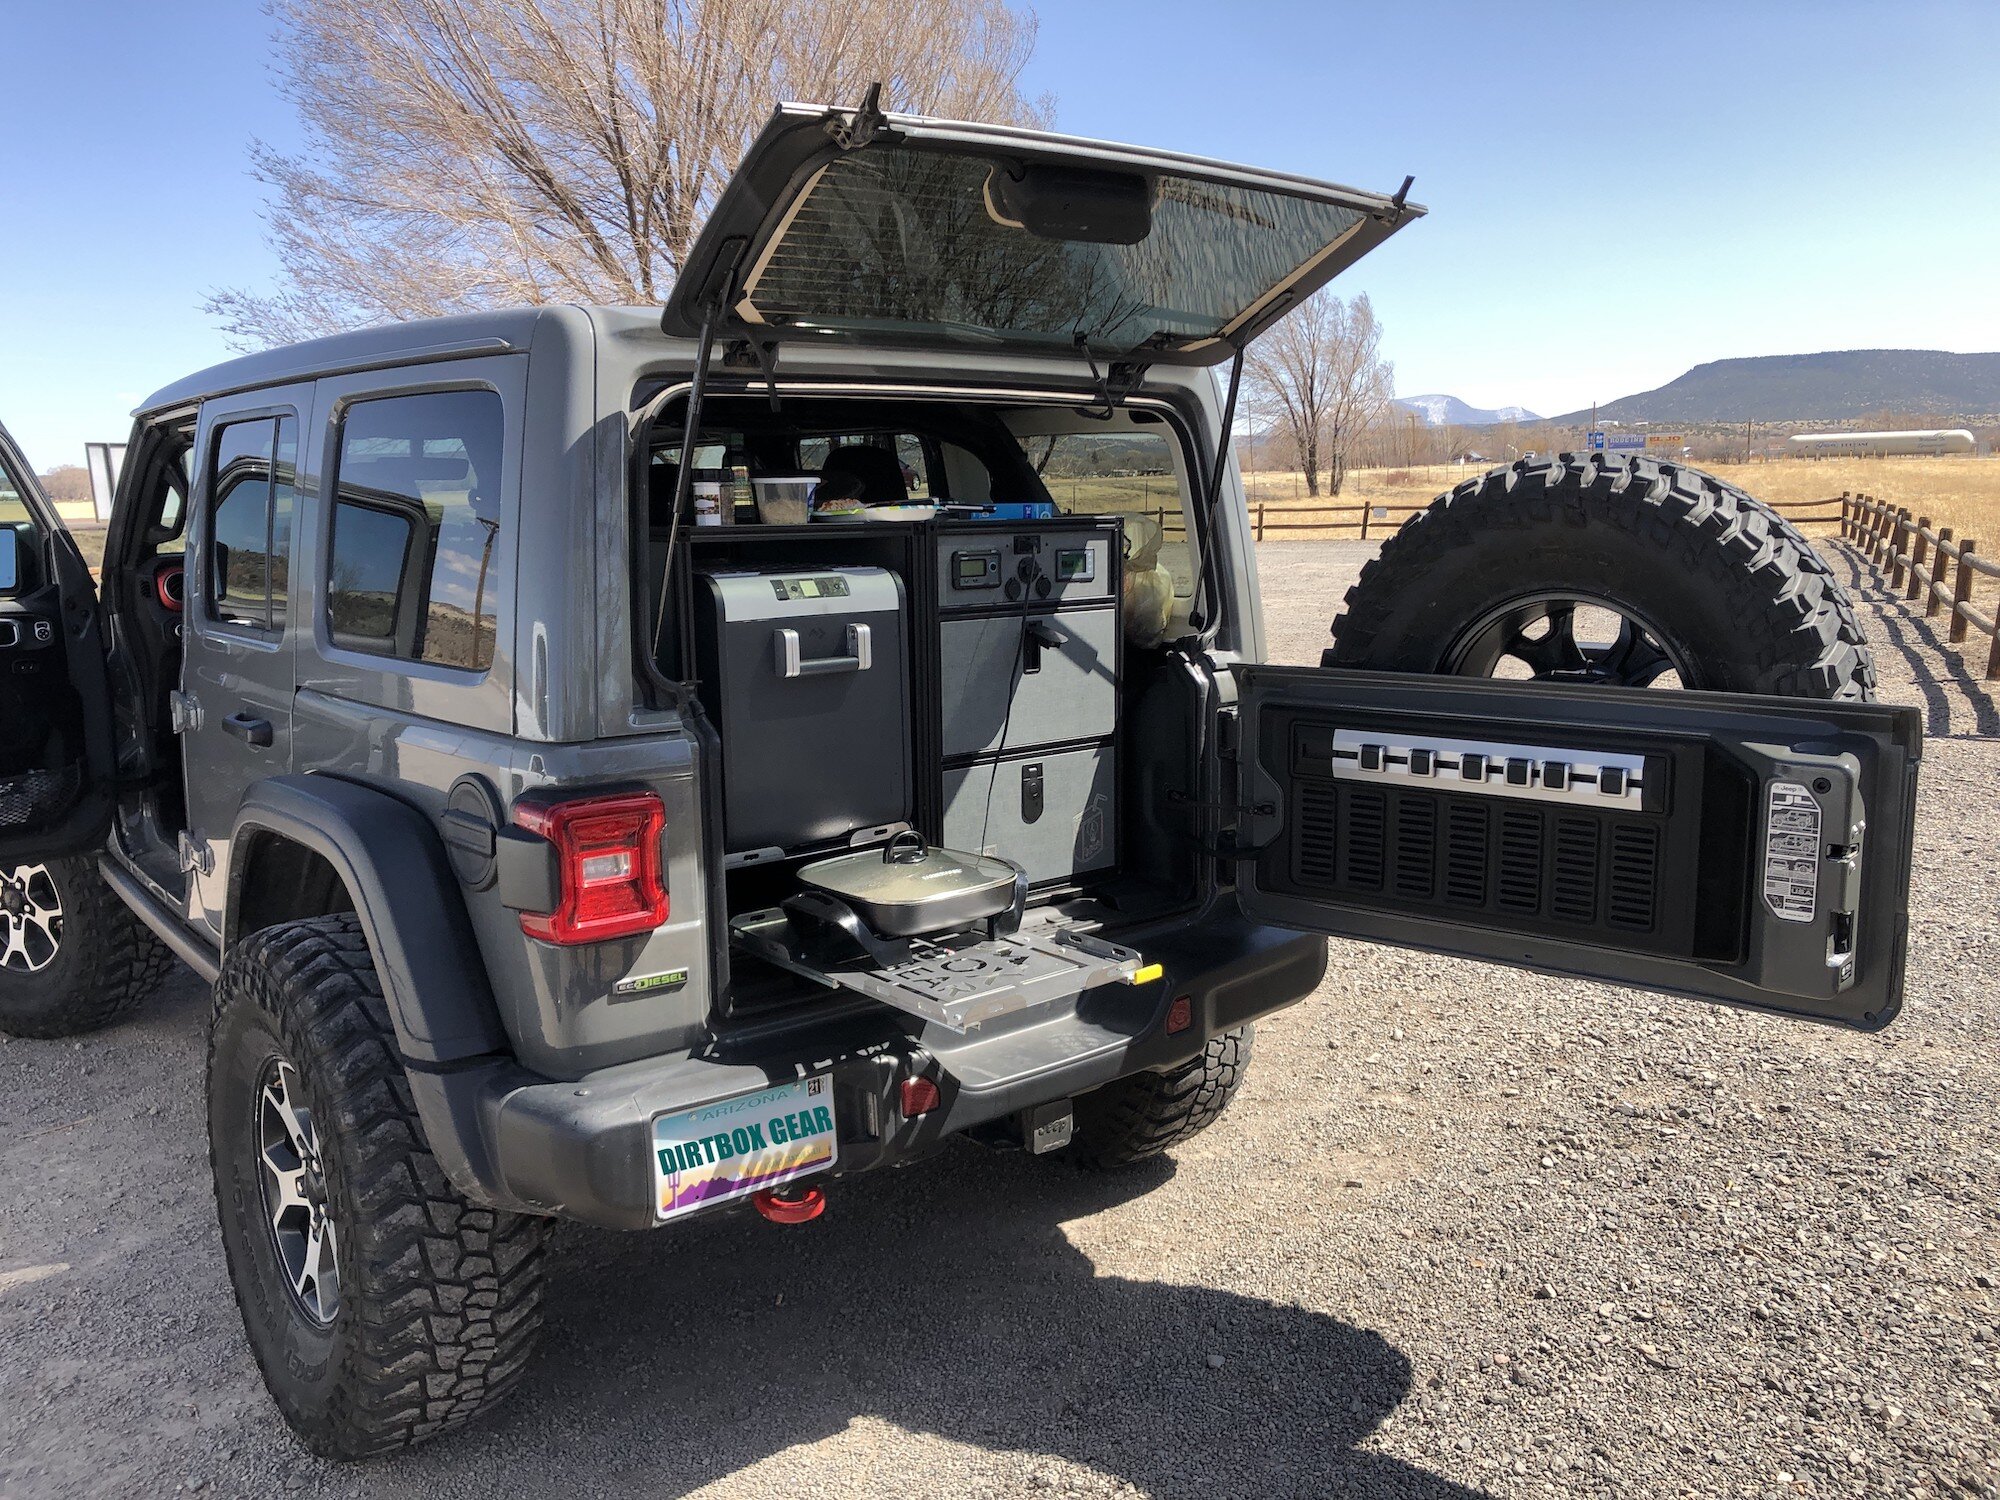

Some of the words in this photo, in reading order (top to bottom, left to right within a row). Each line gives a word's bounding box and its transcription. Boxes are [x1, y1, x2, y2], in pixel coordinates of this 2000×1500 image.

[1780, 785, 1798, 793] Jeep
[701, 1090, 789, 1122] ARIZONA
[808, 1081, 819, 1094] 21
[657, 1122, 767, 1176] DIRTBOX
[768, 1105, 834, 1146] GEAR
